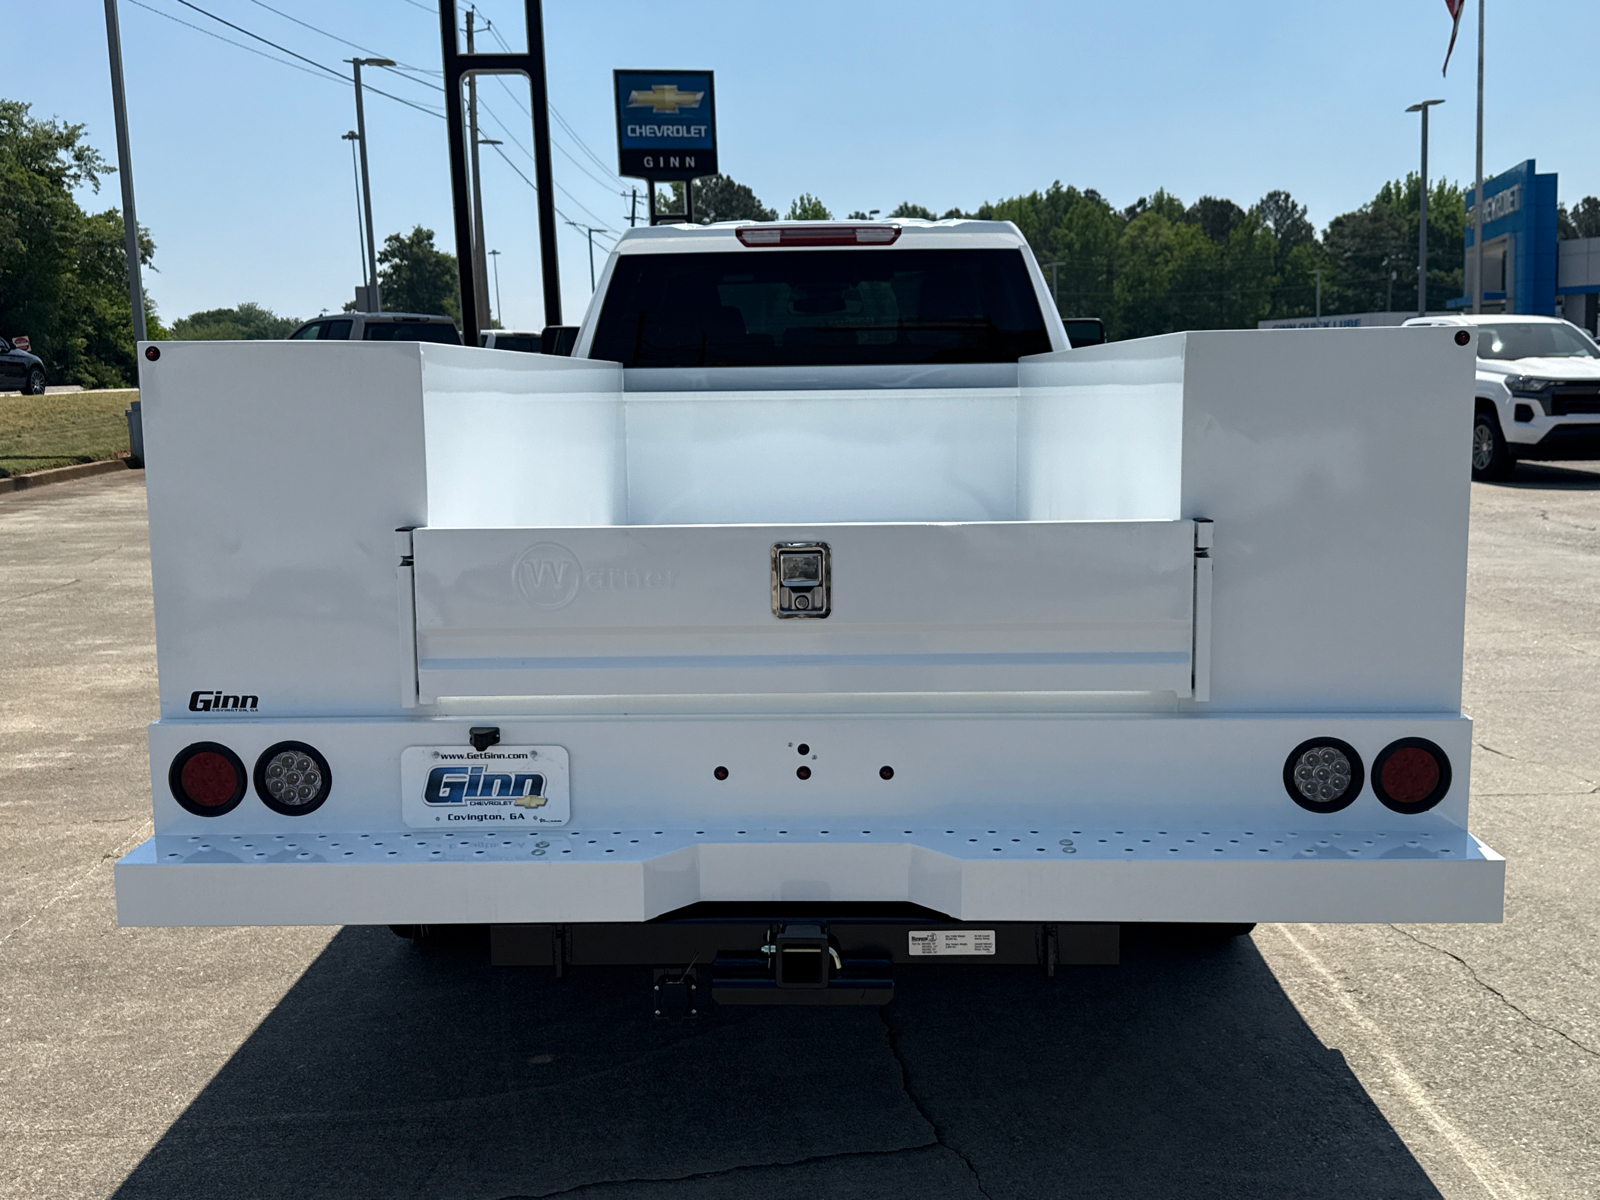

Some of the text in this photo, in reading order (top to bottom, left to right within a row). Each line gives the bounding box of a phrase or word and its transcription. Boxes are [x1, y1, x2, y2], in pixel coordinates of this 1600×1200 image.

[626, 124, 708, 138] CHEVROLET
[643, 156, 696, 168] GINN
[1481, 183, 1521, 224] HEVROLET
[522, 559, 681, 590] Warner
[188, 690, 259, 712] Ginn
[440, 752, 528, 760] www.GetGinn.com
[423, 765, 546, 805] Ginn
[447, 813, 505, 822] Covington,
